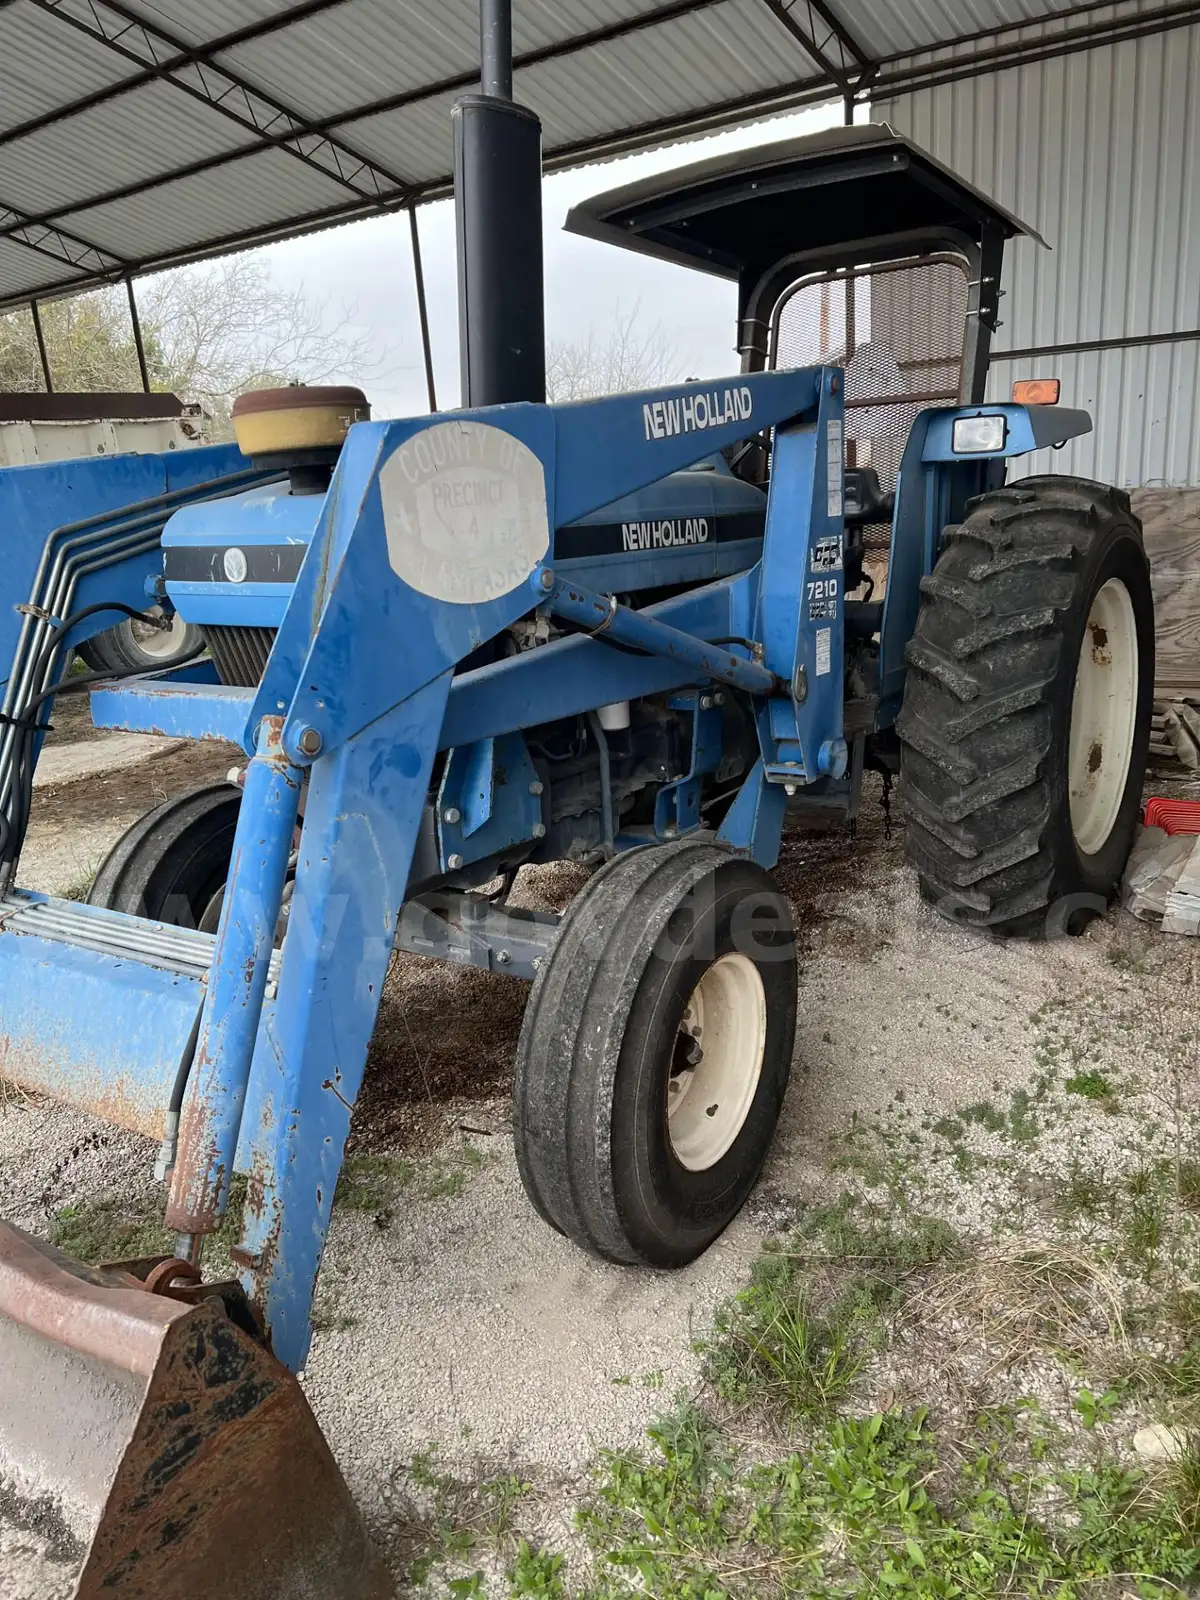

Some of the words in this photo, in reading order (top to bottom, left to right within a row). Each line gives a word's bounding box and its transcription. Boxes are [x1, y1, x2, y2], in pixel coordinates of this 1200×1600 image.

[643, 397, 680, 440] NEW
[682, 387, 753, 432] HOLLAND
[398, 427, 489, 484] COUNTY
[431, 479, 504, 509] PRECINCT
[622, 522, 650, 551] NEW
[652, 518, 709, 547] HOLLAND
[806, 579, 838, 601] 7210
